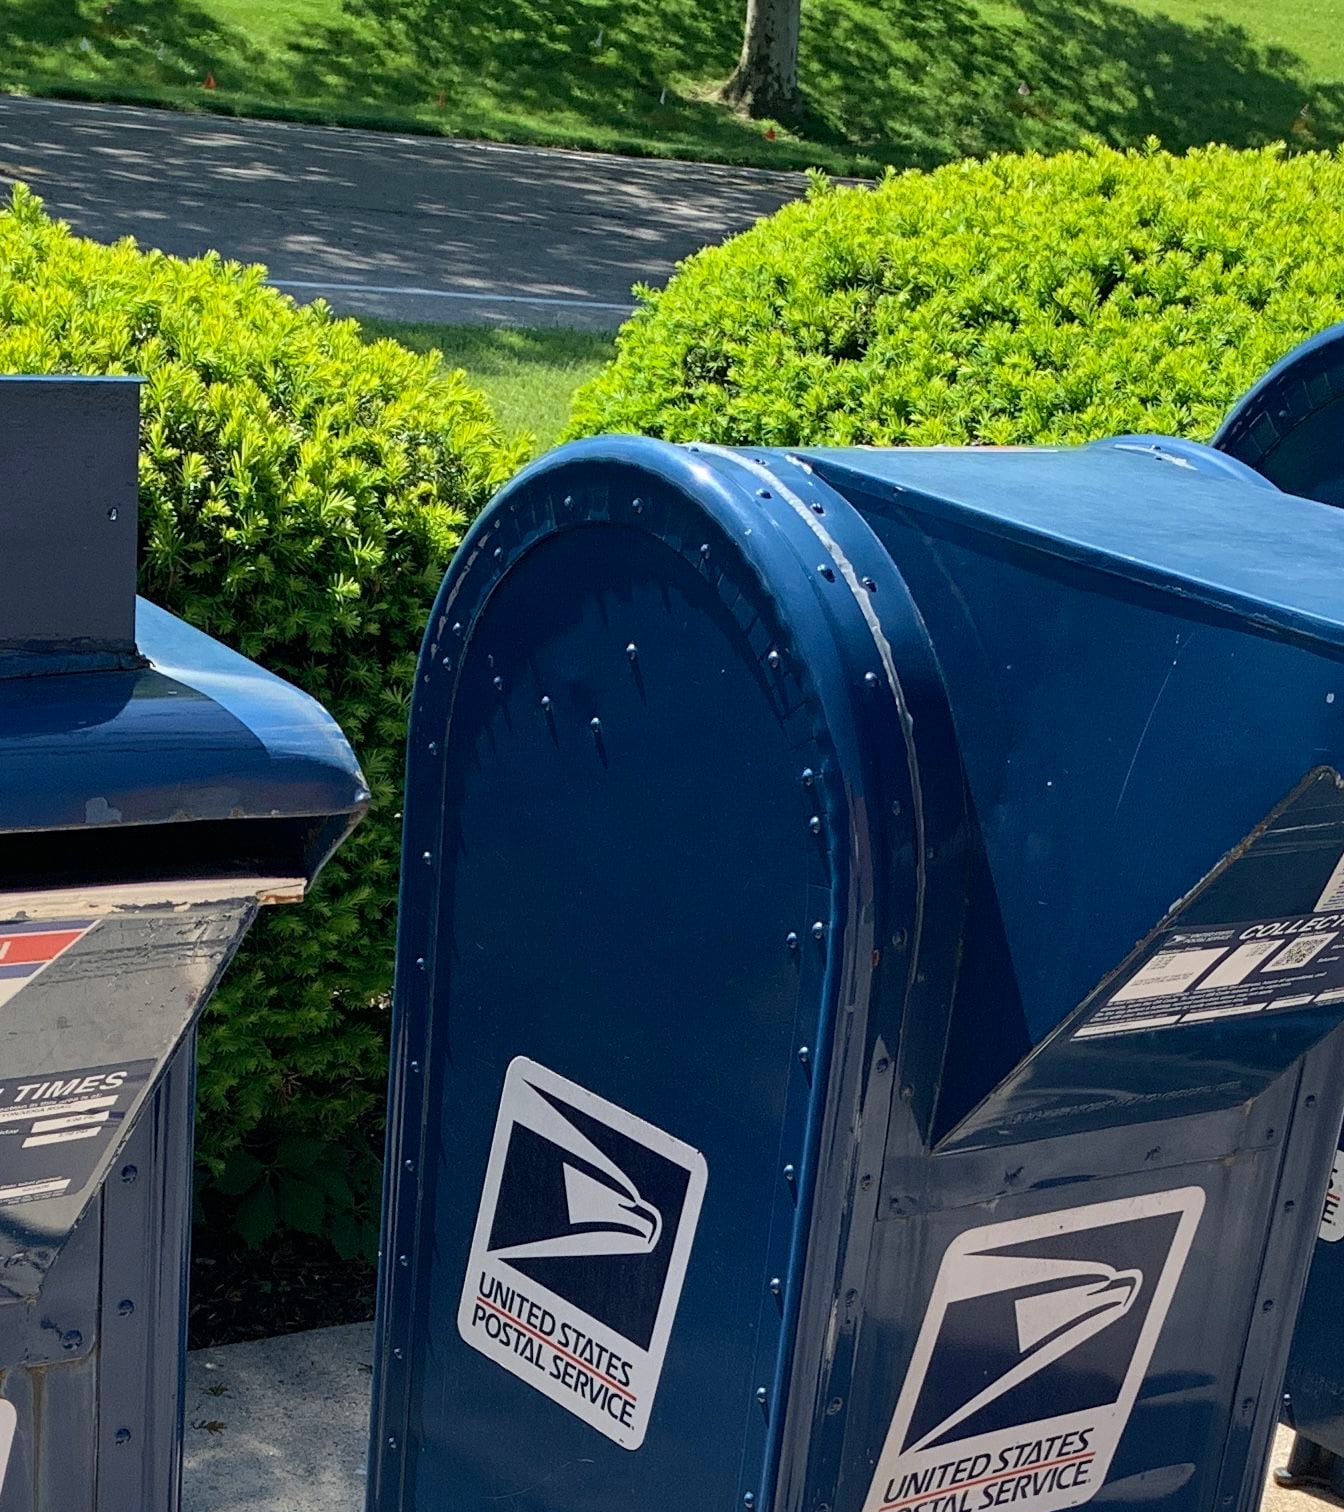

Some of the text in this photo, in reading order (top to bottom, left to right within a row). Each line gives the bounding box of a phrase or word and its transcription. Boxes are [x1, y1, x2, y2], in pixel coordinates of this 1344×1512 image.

[14, 1071, 128, 1102] TIMES
[472, 1304, 636, 1427] POSTAL SERVICE
[479, 1271, 633, 1388] UNITED STATES
[884, 1427, 1095, 1504] UNITED STATES
[979, 1459, 1094, 1509] SERVICE
